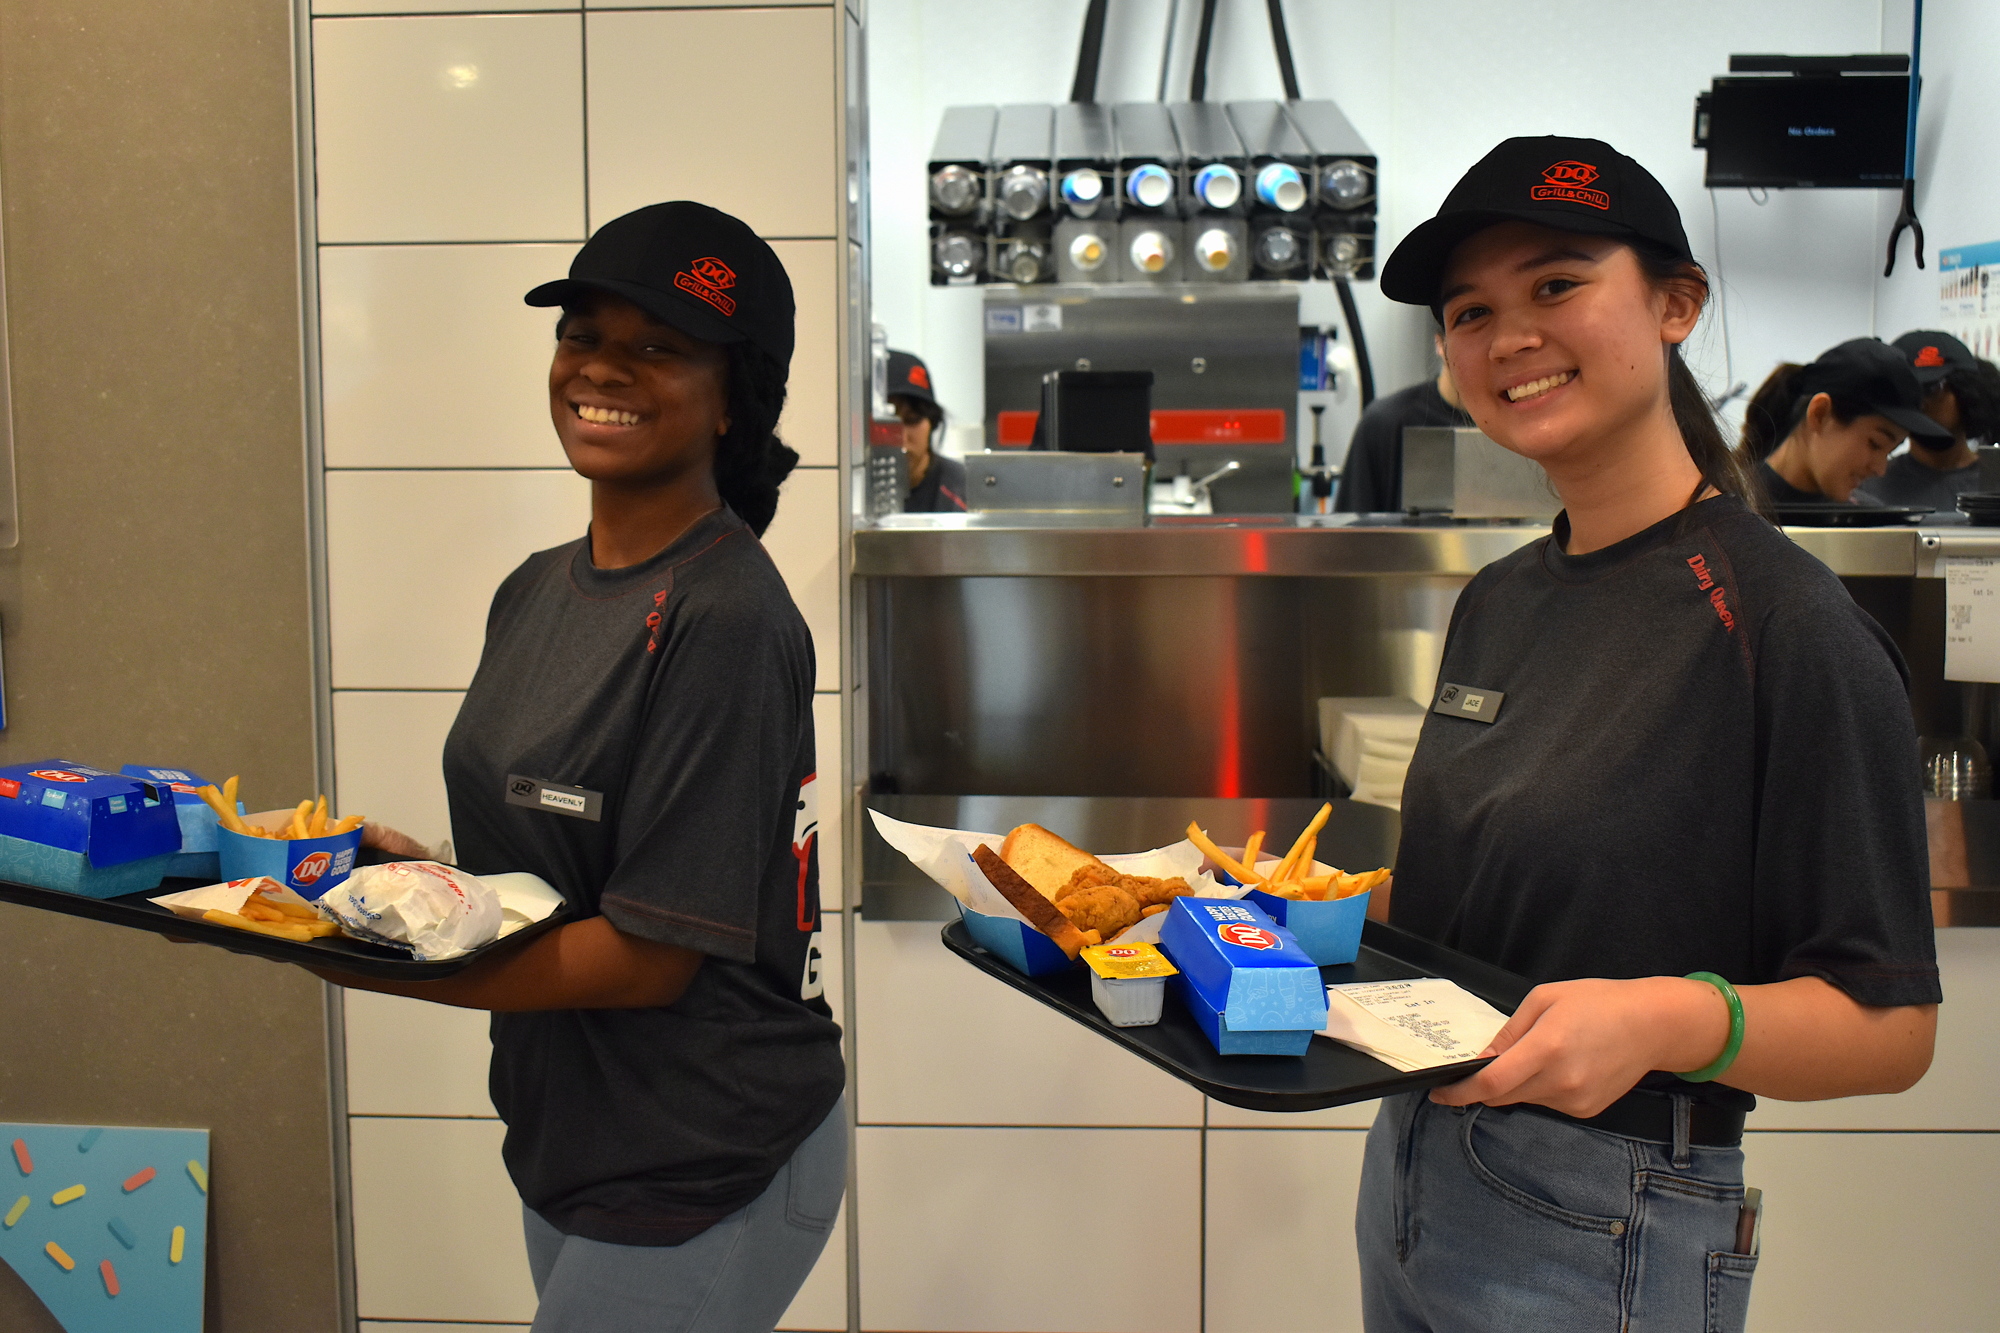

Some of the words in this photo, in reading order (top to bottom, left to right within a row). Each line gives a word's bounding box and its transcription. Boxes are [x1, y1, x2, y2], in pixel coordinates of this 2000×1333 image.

[1552, 166, 1593, 183] DQ
[699, 260, 730, 287] DQ
[542, 793, 584, 807] HEAVENLY
[299, 859, 327, 878] DQ
[331, 863, 350, 876] GOOD
[1230, 926, 1270, 945] DQ
